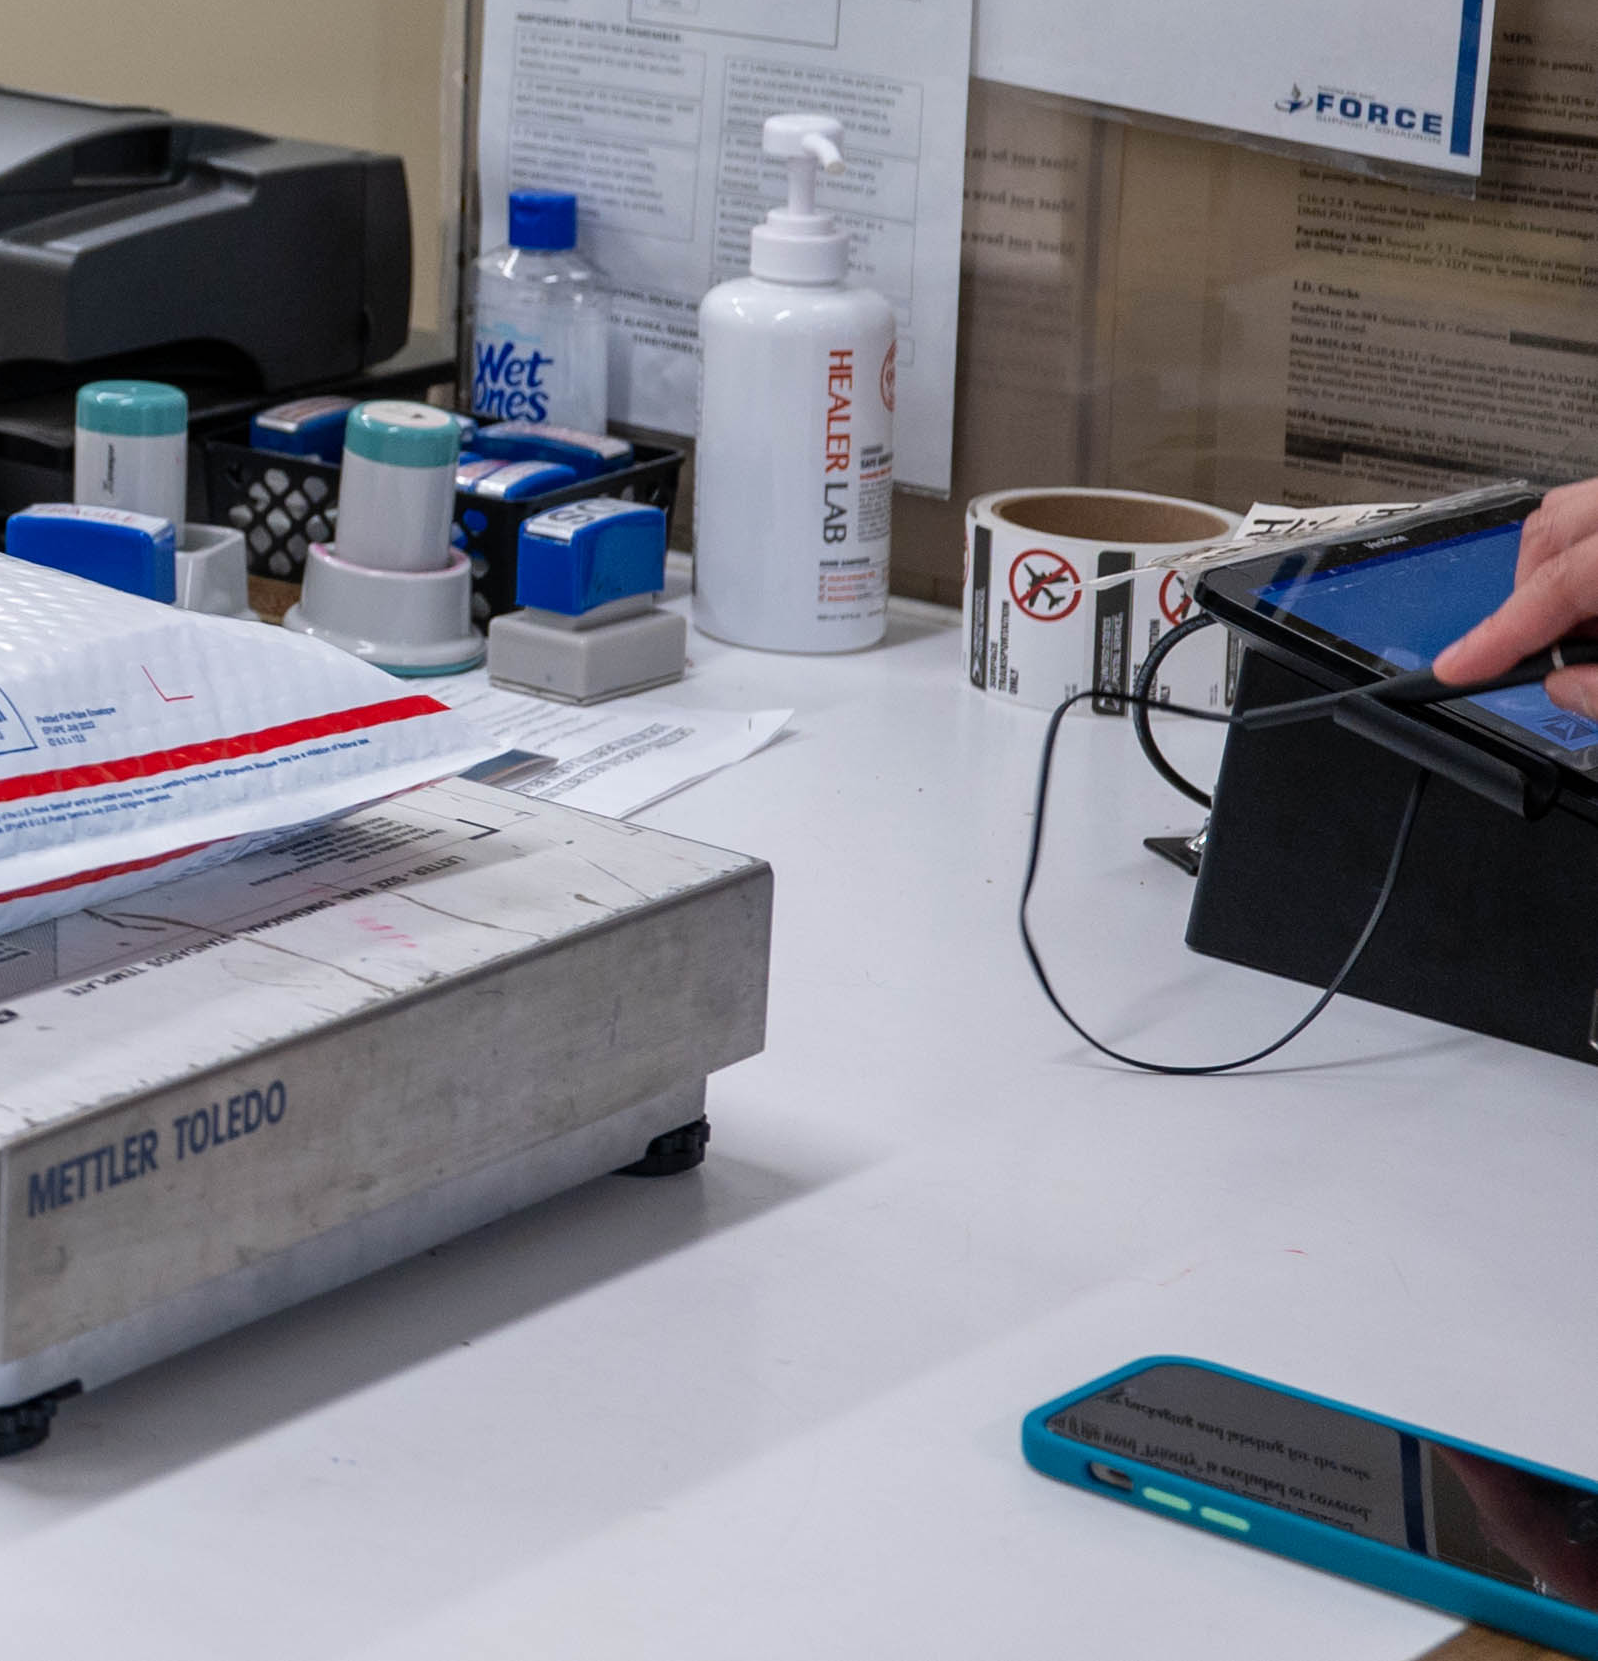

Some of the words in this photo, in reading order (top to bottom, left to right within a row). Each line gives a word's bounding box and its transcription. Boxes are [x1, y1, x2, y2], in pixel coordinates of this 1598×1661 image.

[1317, 92, 1443, 136] FORCE
[476, 341, 553, 388] Wet
[825, 349, 853, 473] HEALER
[823, 482, 849, 544] LAB
[237, 899, 337, 938] DIMENSIONAL
[146, 934, 236, 967] STANDARDS
[68, 963, 148, 997] TEMPLATE
[27, 1128, 159, 1218] METTLER
[173, 1080, 287, 1160] TOLEDO
